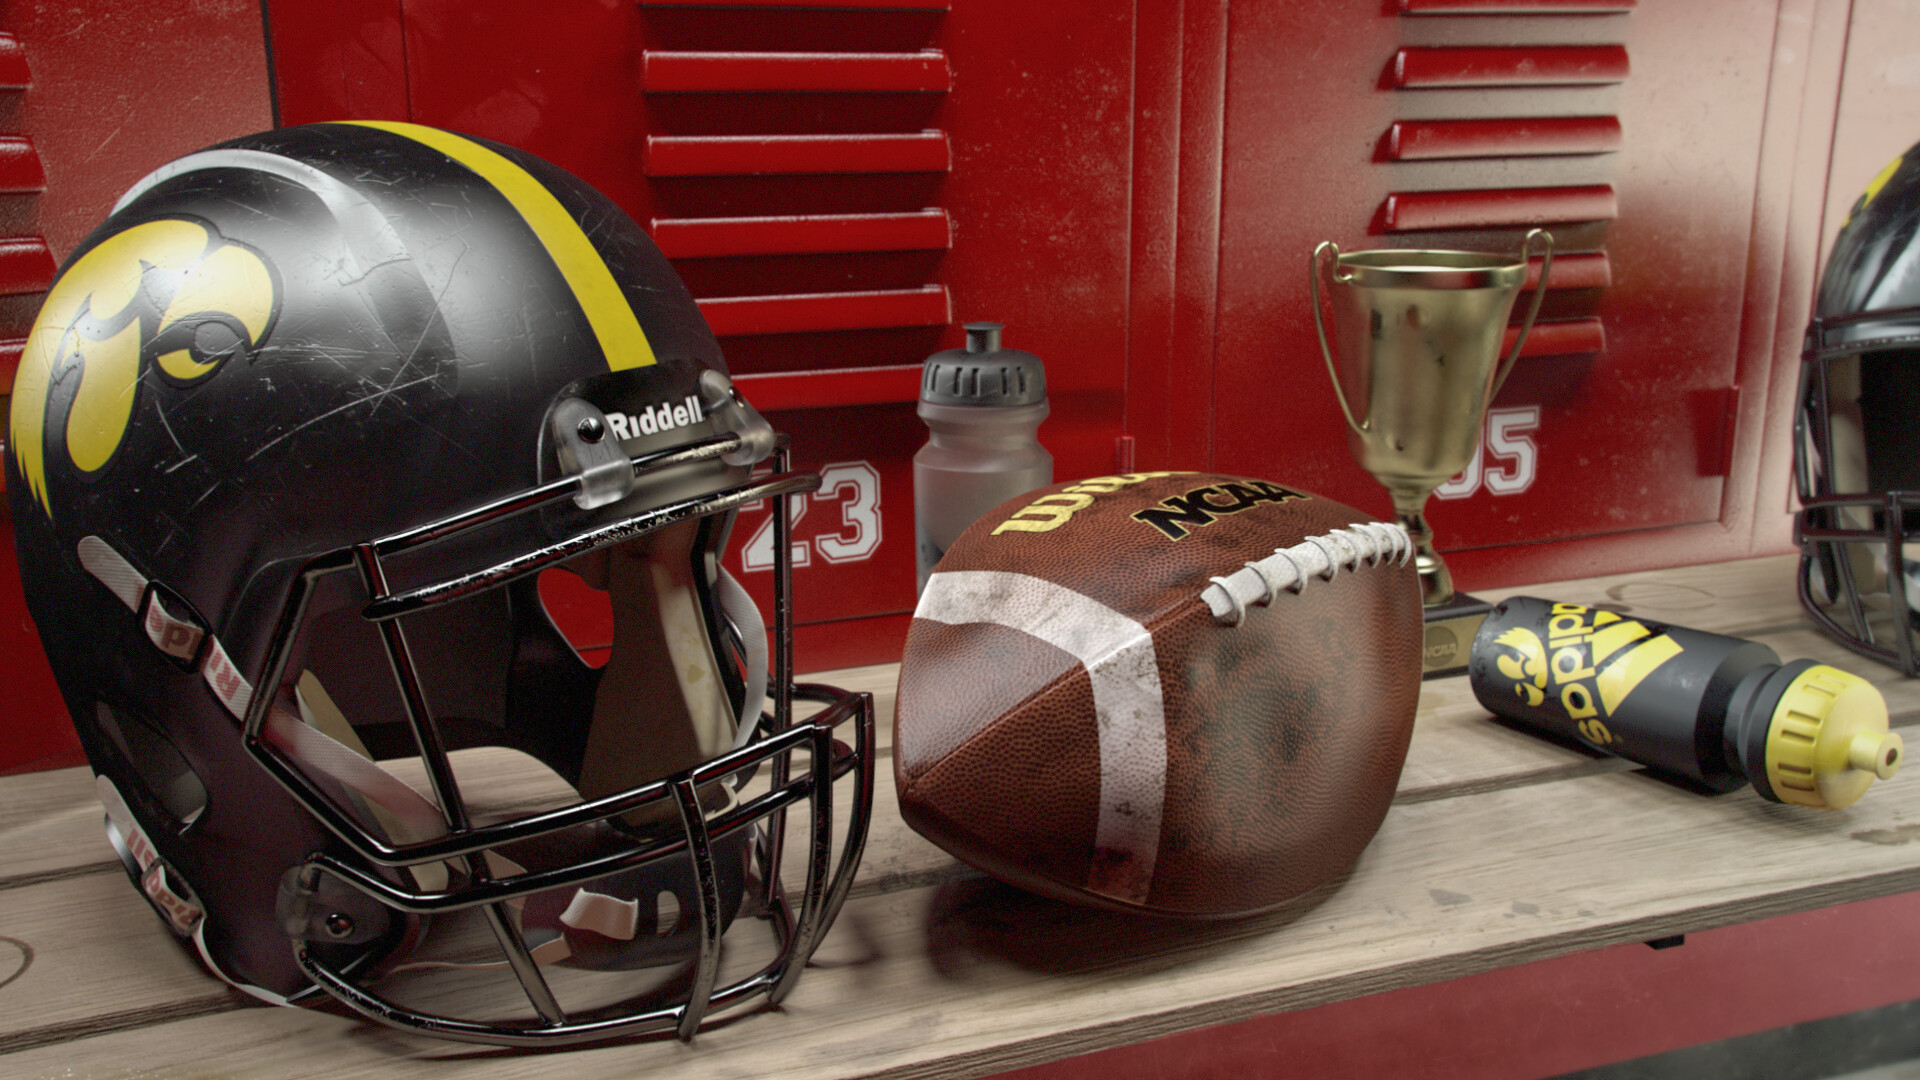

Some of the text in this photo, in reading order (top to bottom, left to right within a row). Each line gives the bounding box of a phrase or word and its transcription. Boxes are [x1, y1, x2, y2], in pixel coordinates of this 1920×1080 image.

[605, 395, 704, 441] Riddell
[740, 460, 883, 573] 23
[1131, 481, 1312, 542] NCAA
[1548, 602, 1613, 745] adidas
